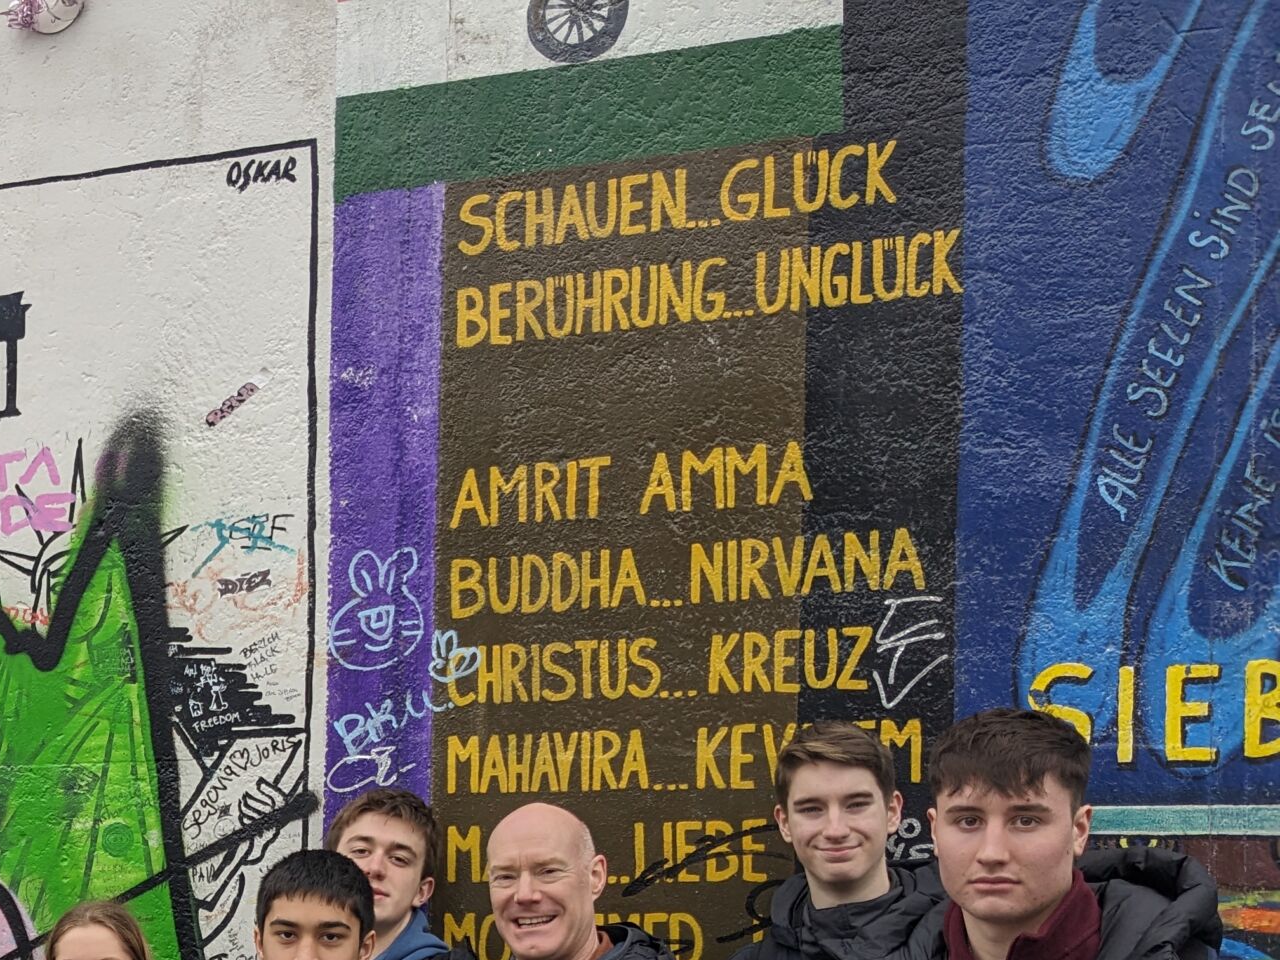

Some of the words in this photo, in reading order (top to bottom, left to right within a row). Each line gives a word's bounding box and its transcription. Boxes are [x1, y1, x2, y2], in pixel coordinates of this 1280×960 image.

[226, 156, 298, 192] OSKAR
[1098, 423, 1153, 522] ALLE
[1126, 268, 1213, 418] SEELEN
[450, 456, 611, 530] AMRIT
[639, 441, 813, 516] AMMA
[192, 711, 242, 733] FREEDOM
[250, 736, 298, 767] JORIS
